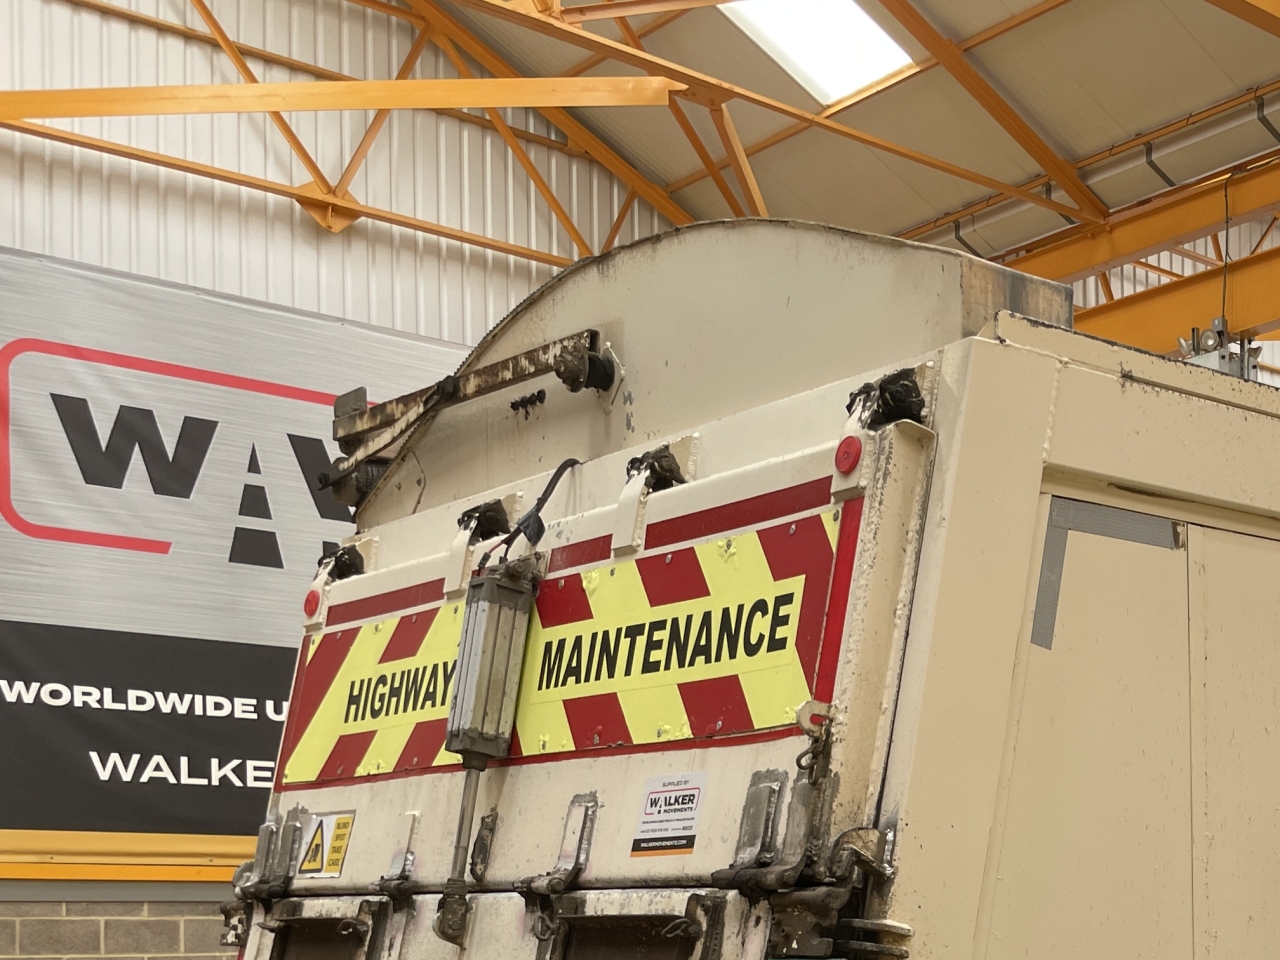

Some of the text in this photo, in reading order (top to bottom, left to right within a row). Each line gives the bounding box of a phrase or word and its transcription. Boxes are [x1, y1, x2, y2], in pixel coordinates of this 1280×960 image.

[538, 591, 795, 692] MAINTENANCE
[0, 679, 258, 719] WORLDWIDE
[344, 659, 458, 724] HIGHWAY
[650, 794, 696, 808] WALKER
[336, 822, 350, 830] BLIND
[332, 846, 343, 854] TAKE
